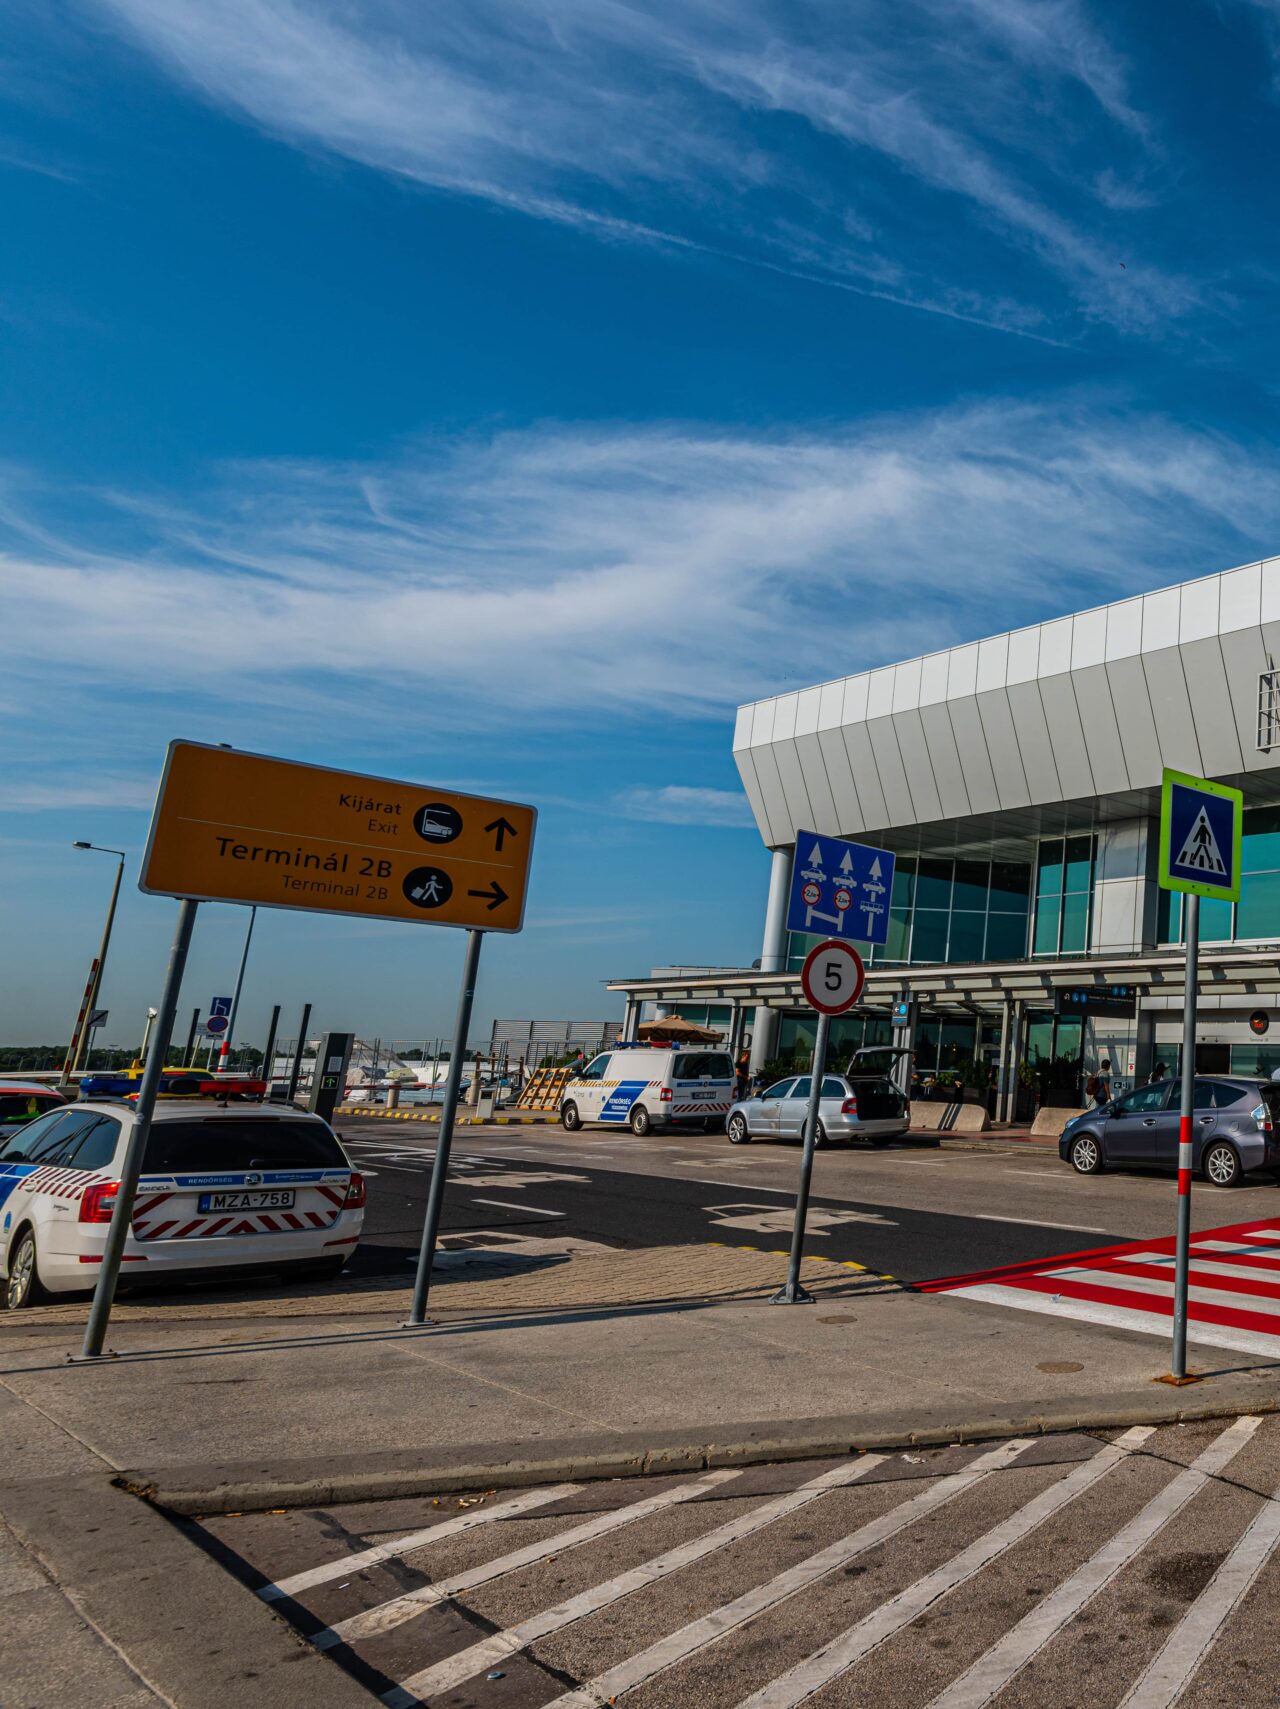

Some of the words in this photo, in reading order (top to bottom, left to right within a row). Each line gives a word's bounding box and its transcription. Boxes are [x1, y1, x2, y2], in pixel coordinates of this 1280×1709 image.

[338, 794, 402, 815] Kijárat
[367, 819, 399, 835] Exit
[216, 837, 349, 873] Terminál
[358, 857, 393, 878] 2B
[282, 875, 360, 897] Terminal
[366, 886, 389, 900] 2B
[824, 962, 842, 991] 5
[213, 1192, 290, 1209] MZA-758
